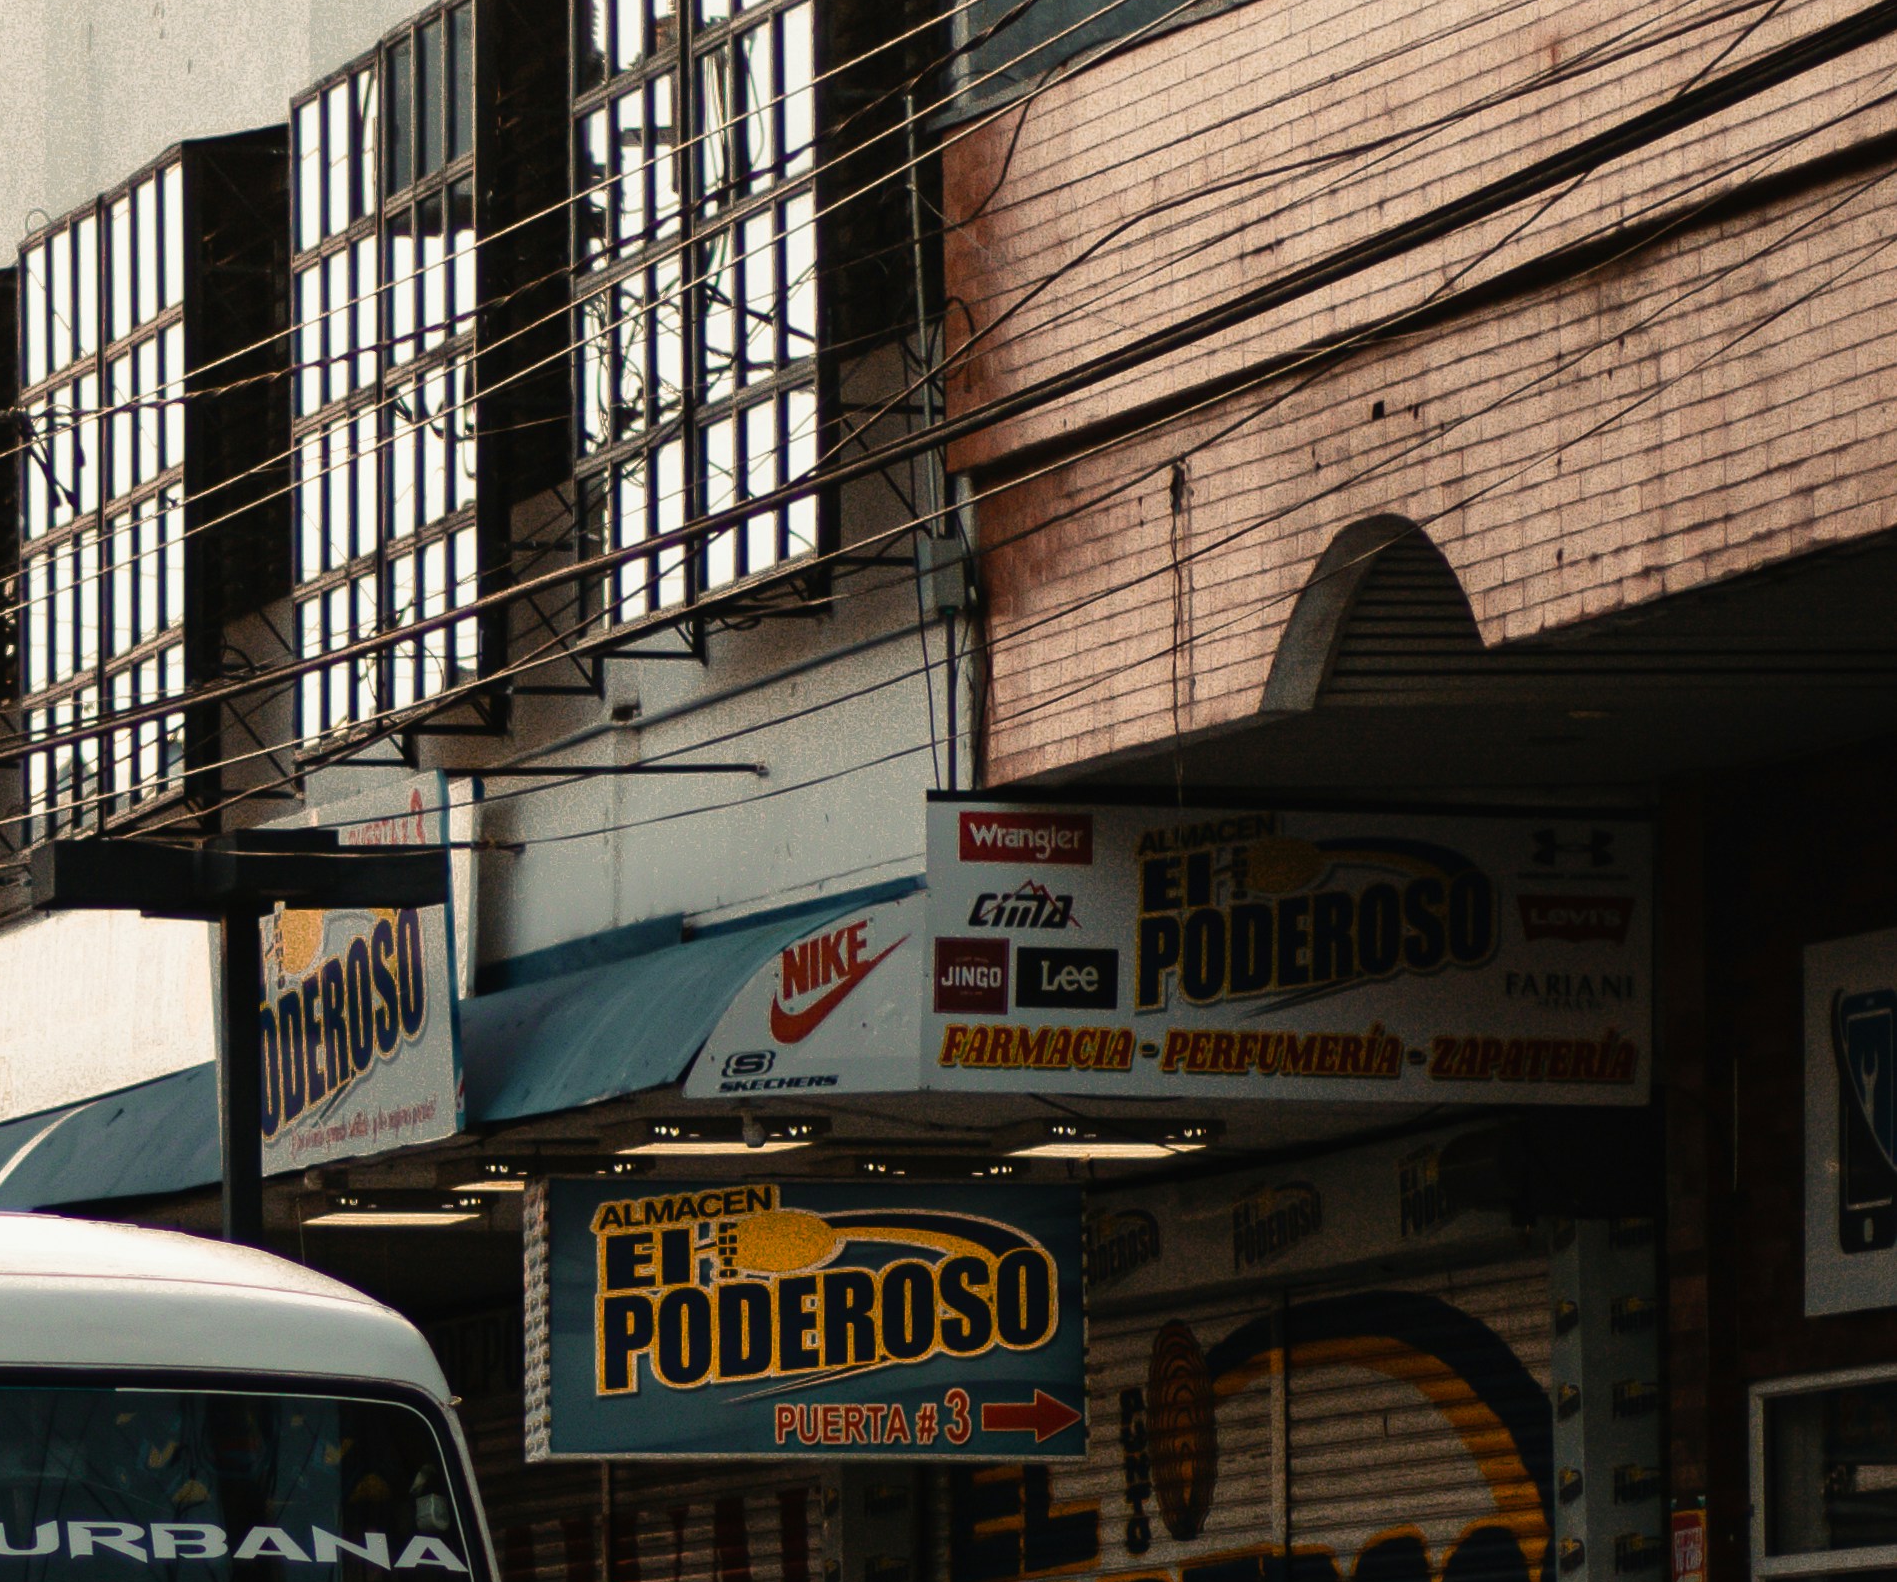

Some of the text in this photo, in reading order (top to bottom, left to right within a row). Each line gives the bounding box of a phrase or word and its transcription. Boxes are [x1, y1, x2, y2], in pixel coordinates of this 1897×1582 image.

[968, 822, 1084, 860] Wrangler
[1138, 813, 1276, 857] ALMACEN
[782, 919, 868, 1001] NIKE
[1138, 870, 1494, 1008] PODEROSO
[940, 965, 1003, 988] JINGO
[1040, 960, 1099, 992] Lee
[1504, 971, 1634, 999] FARIANI
[260, 907, 425, 1137] ODEROSO
[940, 1023, 1133, 1071] FARMACIA
[1162, 1022, 1402, 1077] PERFUMERÍA
[1431, 1027, 1638, 1082] ZAPATERÍA
[719, 1074, 839, 1093] SKECHERS
[600, 1186, 772, 1230] ALMACEN
[602, 1248, 1054, 1392] PODEROSO
[775, 1403, 908, 1444] PUERTA
